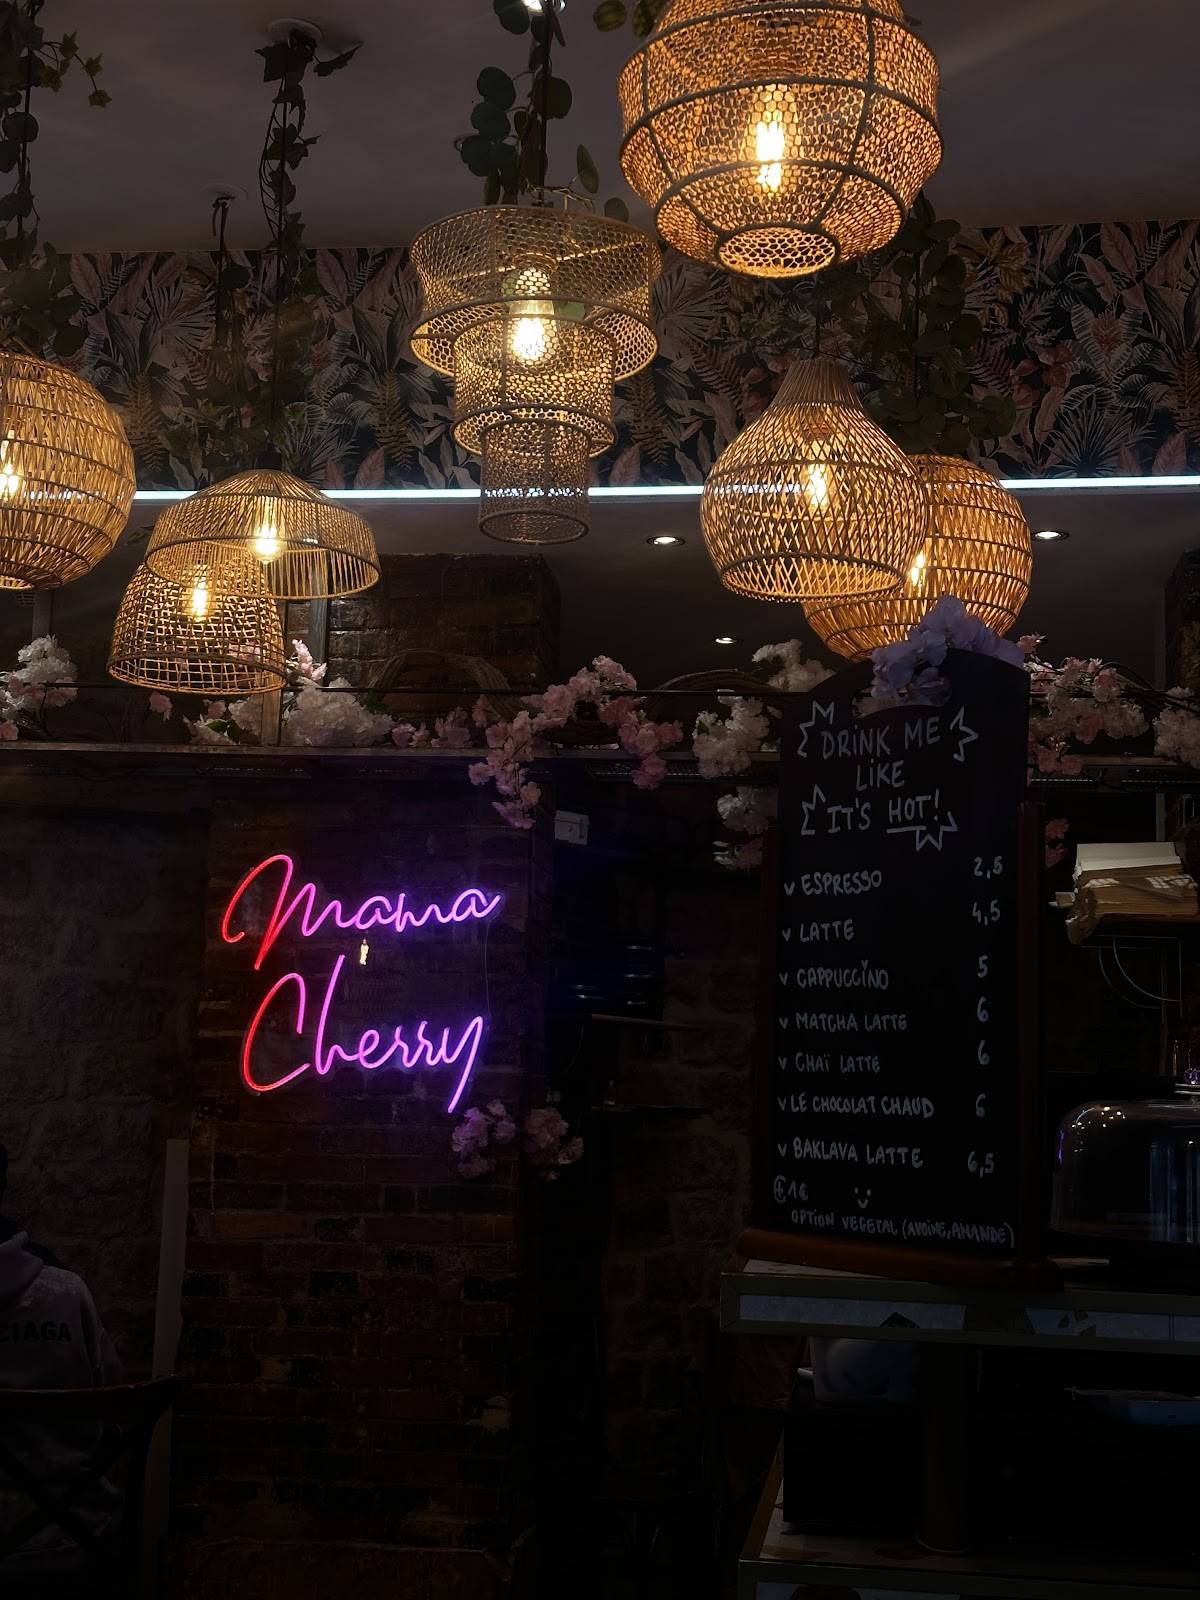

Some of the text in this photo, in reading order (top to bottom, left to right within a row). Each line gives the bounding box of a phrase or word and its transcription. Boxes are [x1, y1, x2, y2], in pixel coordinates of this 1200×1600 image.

[904, 716, 941, 750] ME
[827, 788, 940, 834] IT'S HOT!
[801, 855, 1003, 897] ESPRESSO 2,5
[220, 853, 503, 971] Mama
[799, 899, 1001, 943] LATTE 4,5
[977, 955, 989, 978] 5
[795, 996, 990, 1033] MATCHA LATTE 6
[242, 953, 484, 1113] Cherry
[839, 1055, 881, 1074] LATTE
[977, 1040, 990, 1066] 6
[812, 1095, 877, 1115] CHOCOLAT
[880, 1096, 935, 1119] CHAUD
[975, 1093, 987, 1118] 6
[792, 1136, 859, 1162] BAKLAVA
[865, 1143, 924, 1169] LATTE
[841, 1215, 899, 1238] VEGETAL
